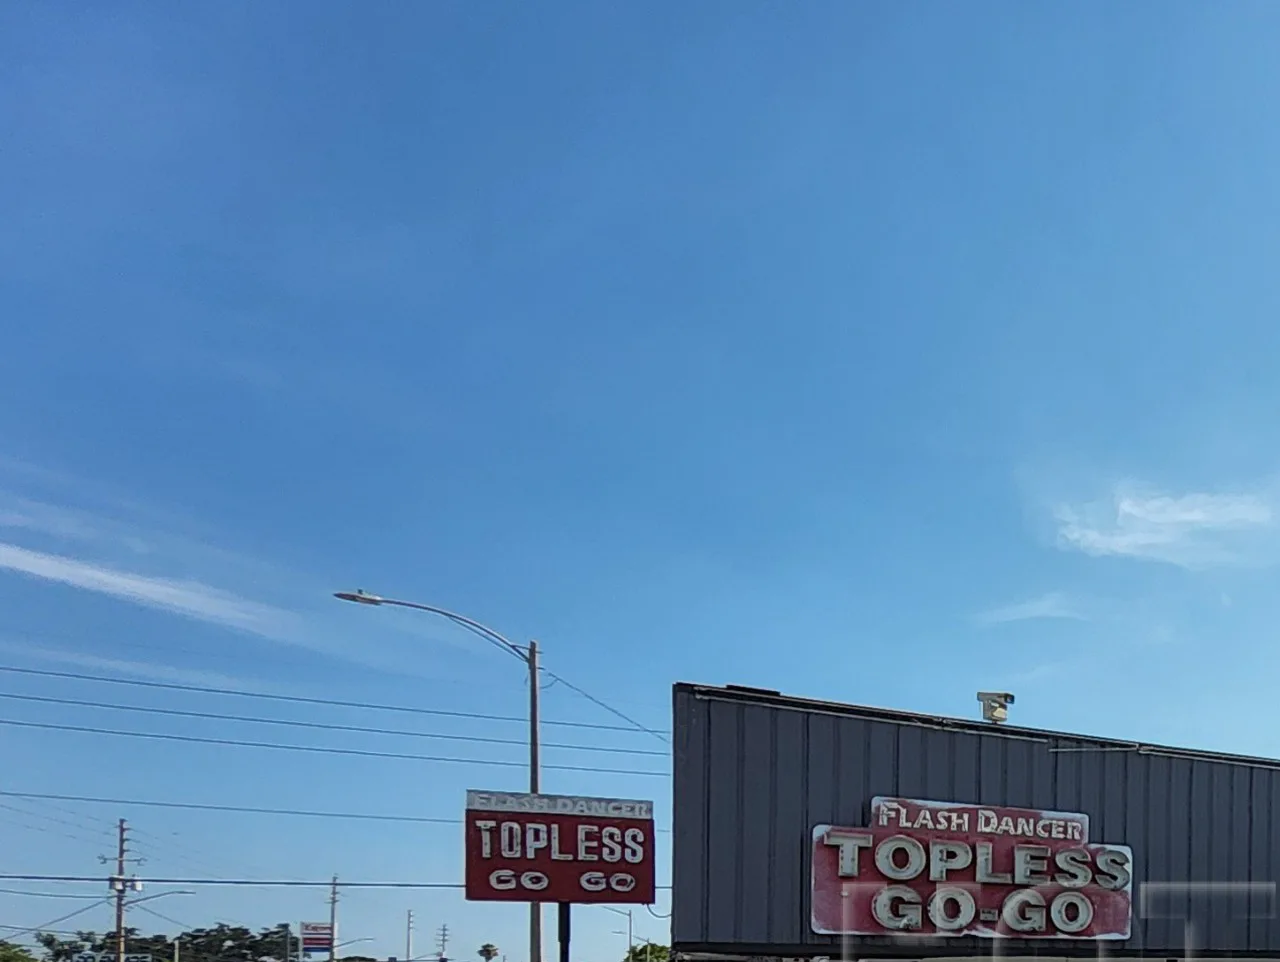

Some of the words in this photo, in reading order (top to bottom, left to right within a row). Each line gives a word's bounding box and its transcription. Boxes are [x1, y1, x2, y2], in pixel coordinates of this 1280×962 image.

[557, 798, 650, 818] DANCER
[475, 820, 645, 863] TOPLESS
[824, 833, 1130, 890] TOPLESS
[489, 869, 549, 890] GO
[579, 871, 636, 892] GO
[872, 886, 1093, 933] GO-GO
